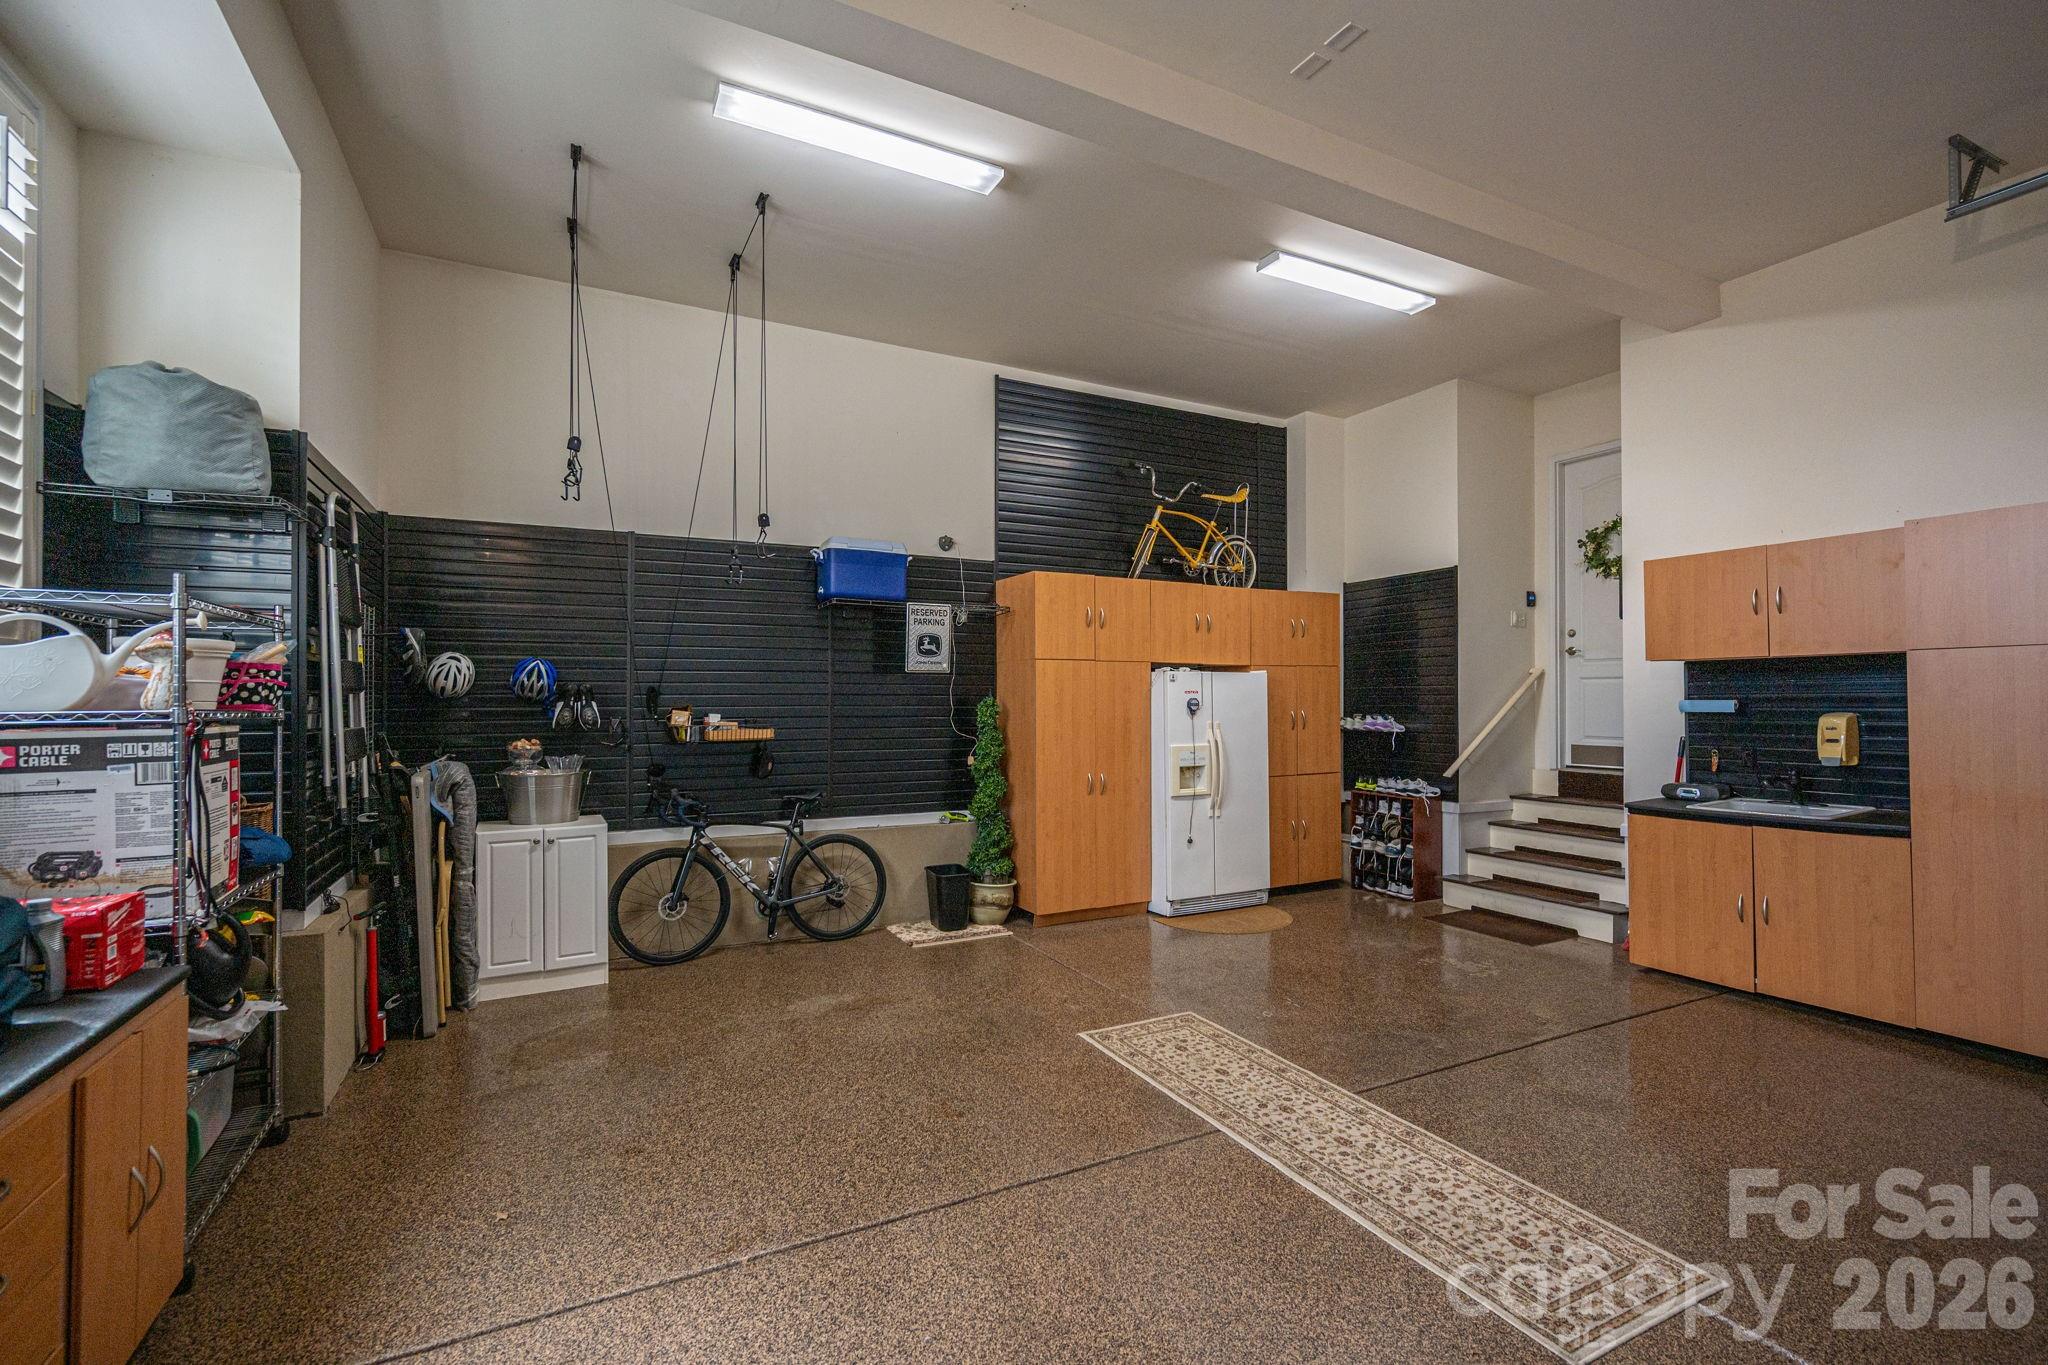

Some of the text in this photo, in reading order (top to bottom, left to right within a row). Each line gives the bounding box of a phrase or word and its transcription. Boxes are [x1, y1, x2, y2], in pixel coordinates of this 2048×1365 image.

[911, 609, 948, 617] RESERVED
[913, 618, 946, 626] PARKING
[19, 745, 81, 756] PORTER
